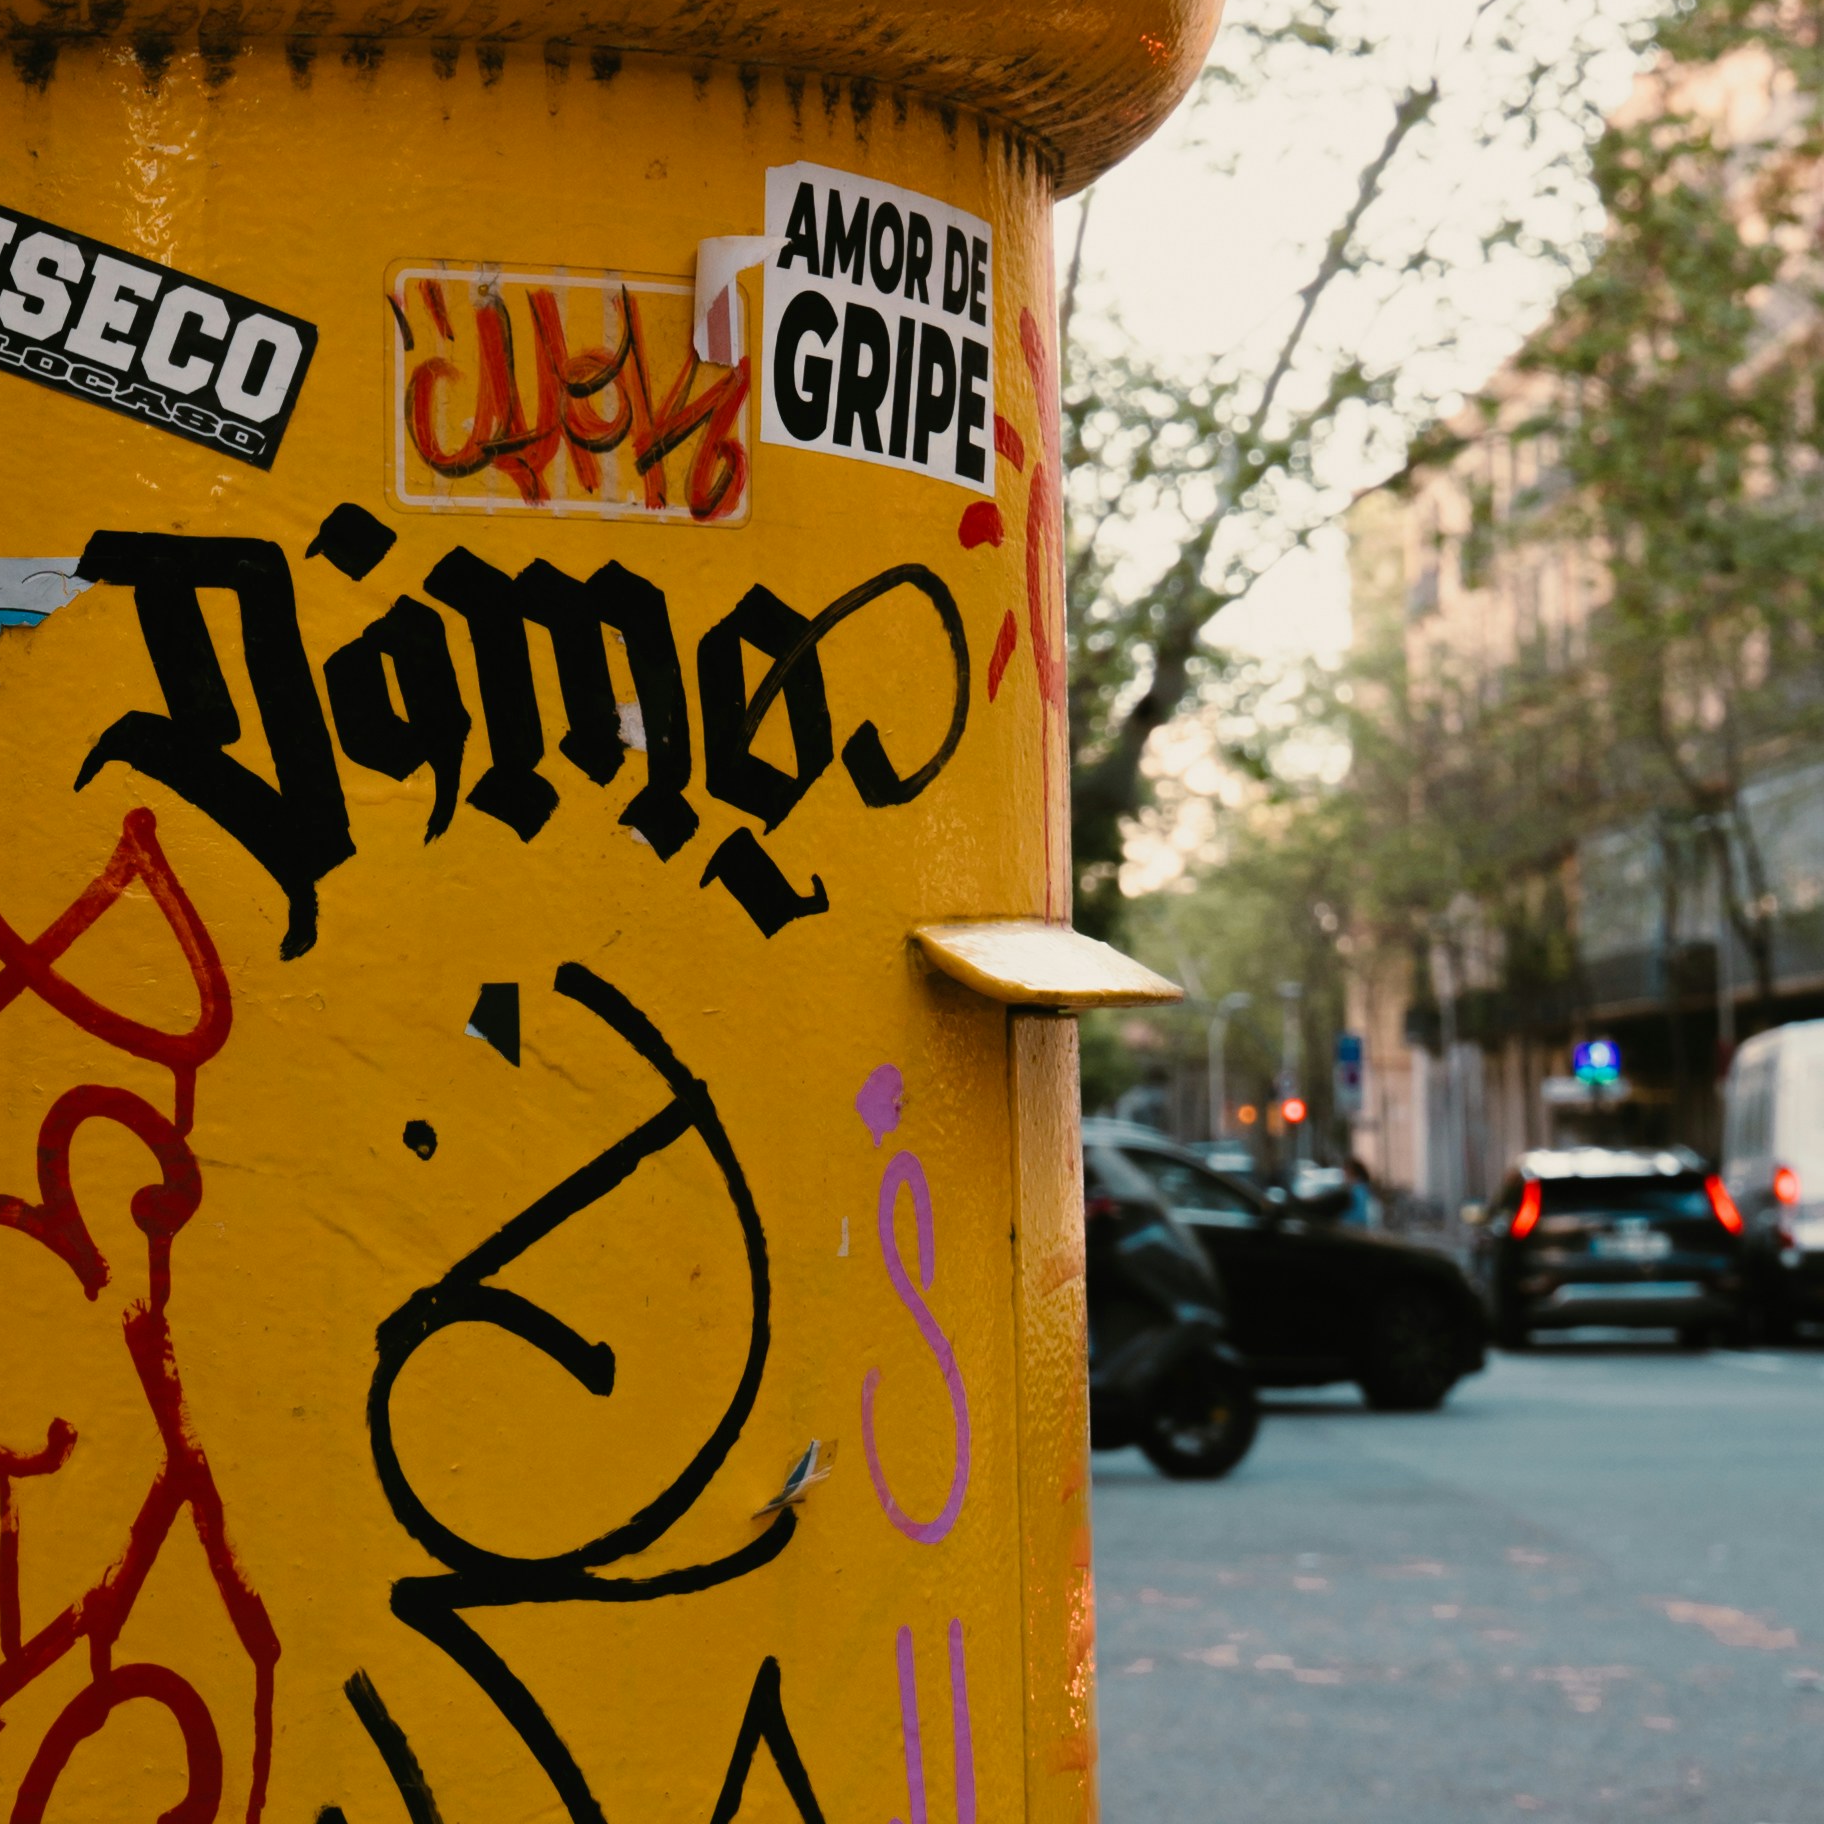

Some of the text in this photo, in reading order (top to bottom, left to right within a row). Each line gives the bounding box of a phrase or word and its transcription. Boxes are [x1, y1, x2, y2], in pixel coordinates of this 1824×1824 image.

[776, 181, 989, 328] AMOR DE
[774, 289, 990, 484] GRIPE
